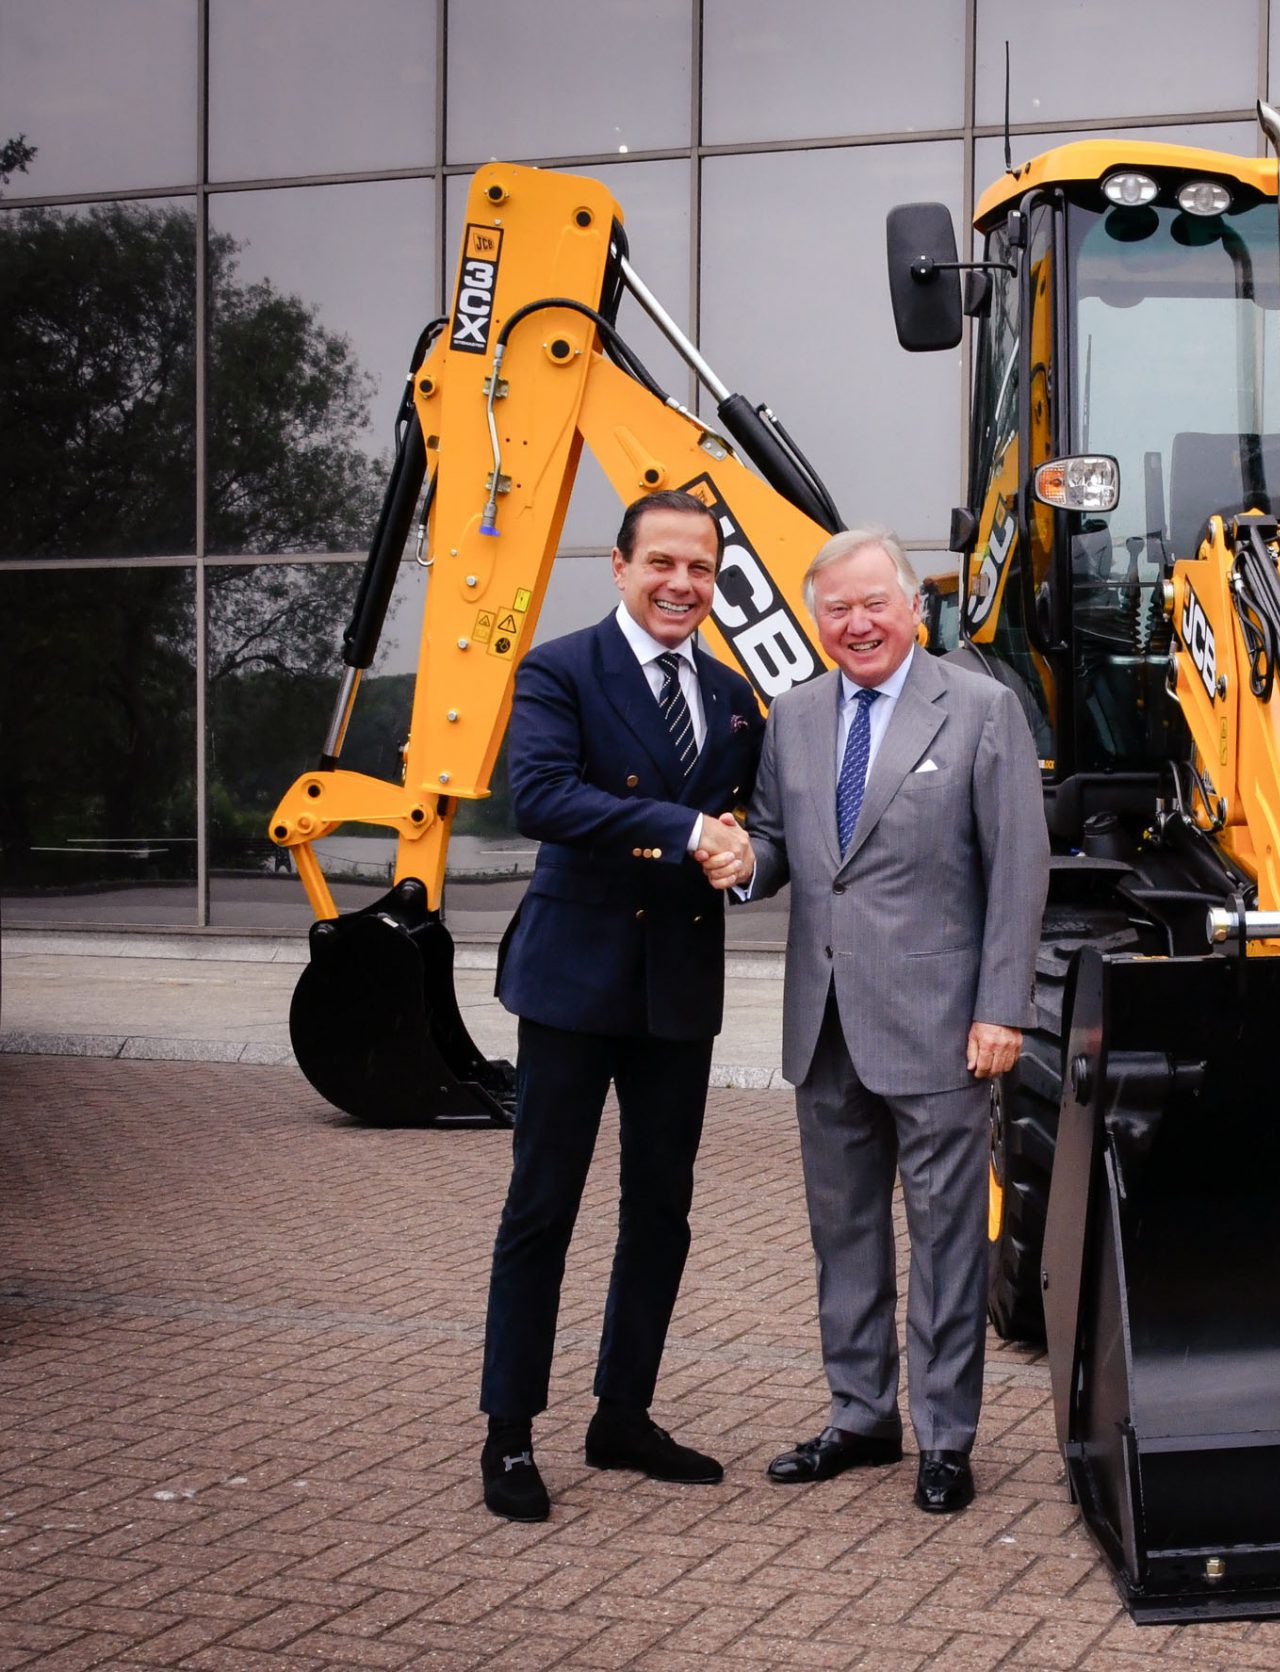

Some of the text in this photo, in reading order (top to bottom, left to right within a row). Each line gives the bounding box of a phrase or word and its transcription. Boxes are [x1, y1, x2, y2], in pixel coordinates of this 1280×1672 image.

[475, 234, 494, 251] JCB
[453, 261, 495, 343] 3CX
[1182, 591, 1217, 699] JCB
